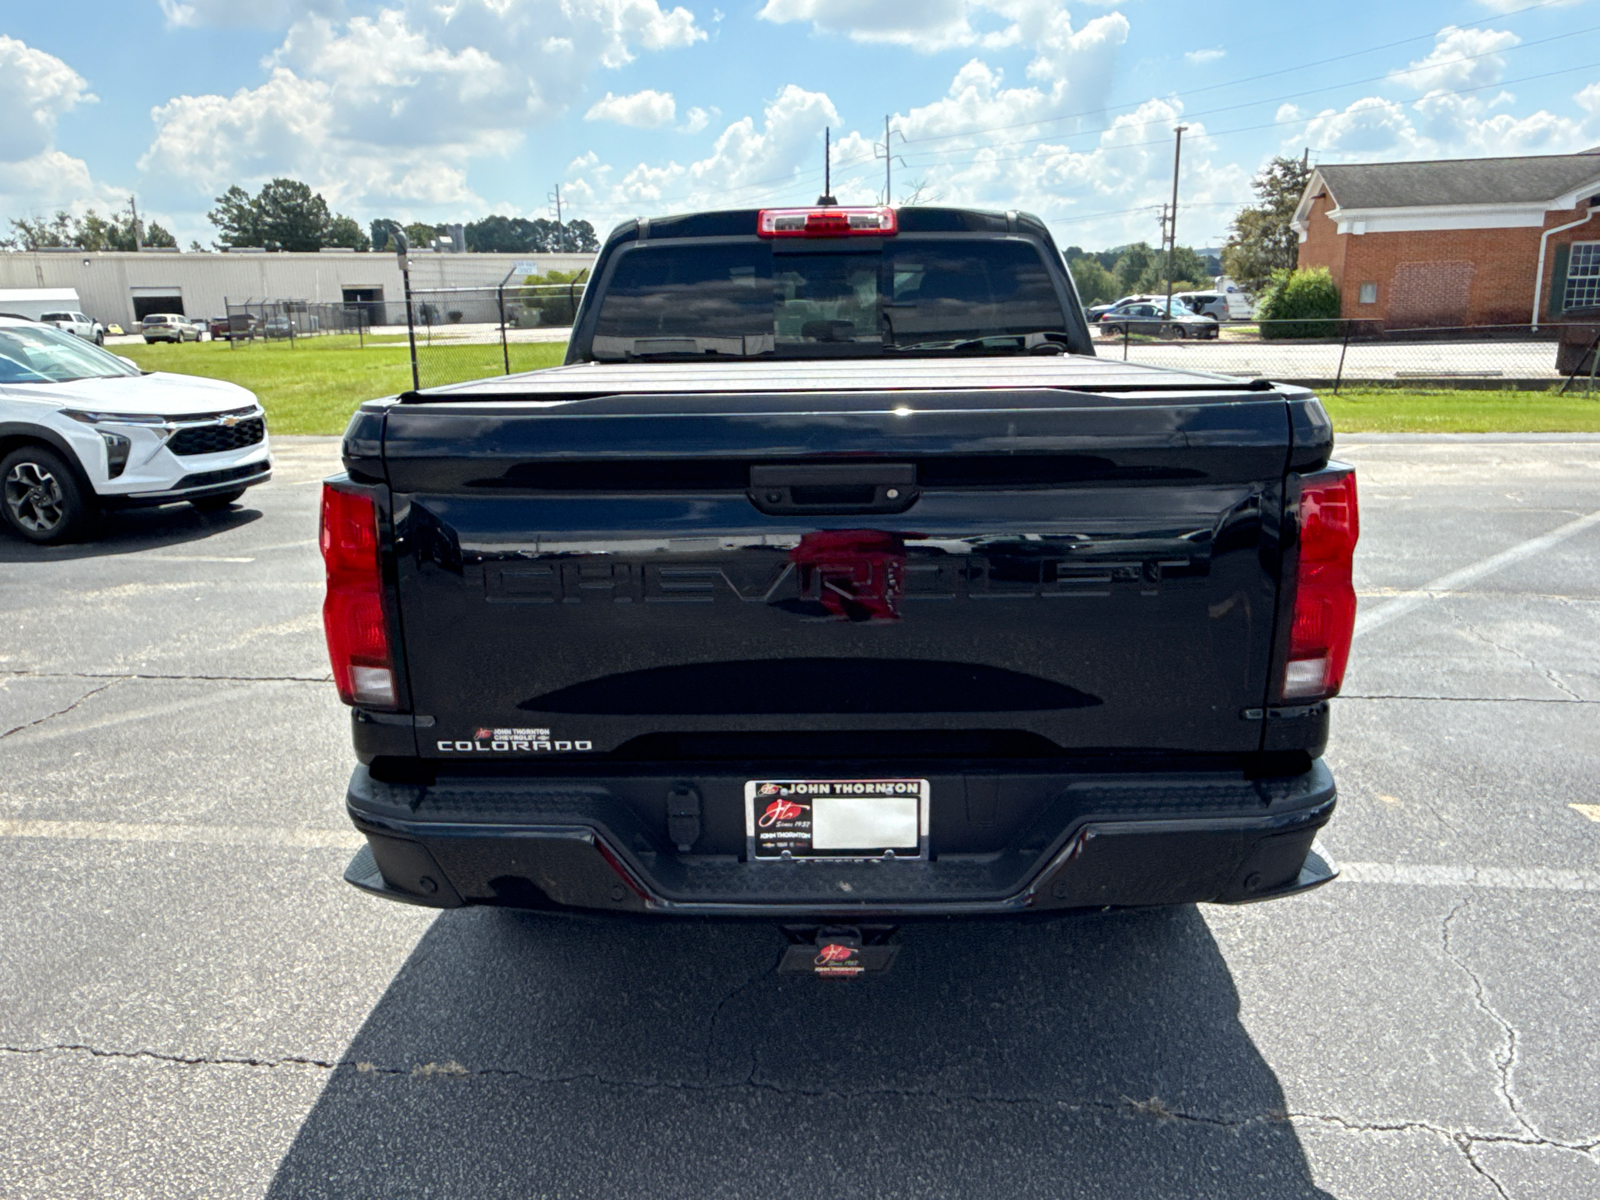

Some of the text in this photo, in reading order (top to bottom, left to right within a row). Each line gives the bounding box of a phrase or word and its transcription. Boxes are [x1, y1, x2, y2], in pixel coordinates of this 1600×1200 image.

[485, 561, 1190, 601] CHEVROLET
[437, 740, 592, 751] COLORADO
[789, 783, 830, 794] JOHN
[834, 783, 919, 794] THORNTON
